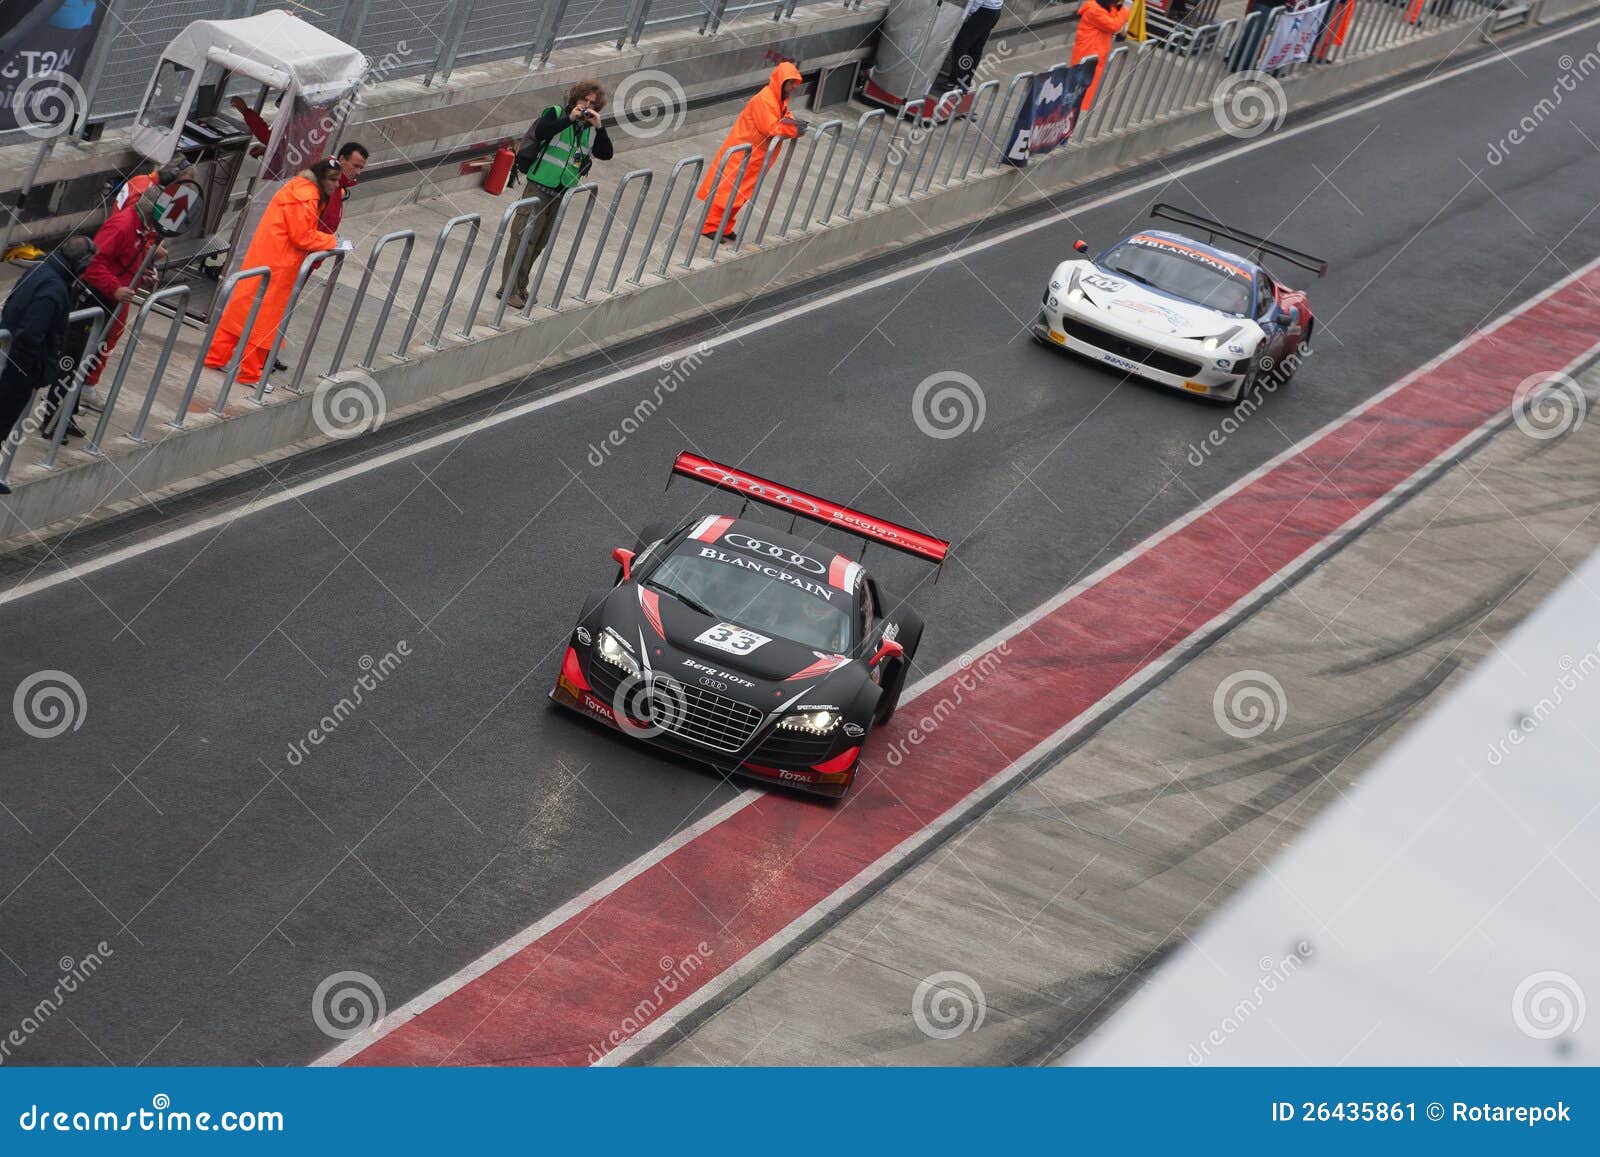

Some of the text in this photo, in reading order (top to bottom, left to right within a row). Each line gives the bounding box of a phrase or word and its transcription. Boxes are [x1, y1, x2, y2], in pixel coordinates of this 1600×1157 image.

[833, 511, 898, 538] Belgian
[698, 547, 833, 601] BLANCPAIN
[709, 628, 756, 650] 33
[584, 695, 614, 720] TOTAL
[779, 769, 812, 783] TOTAL
